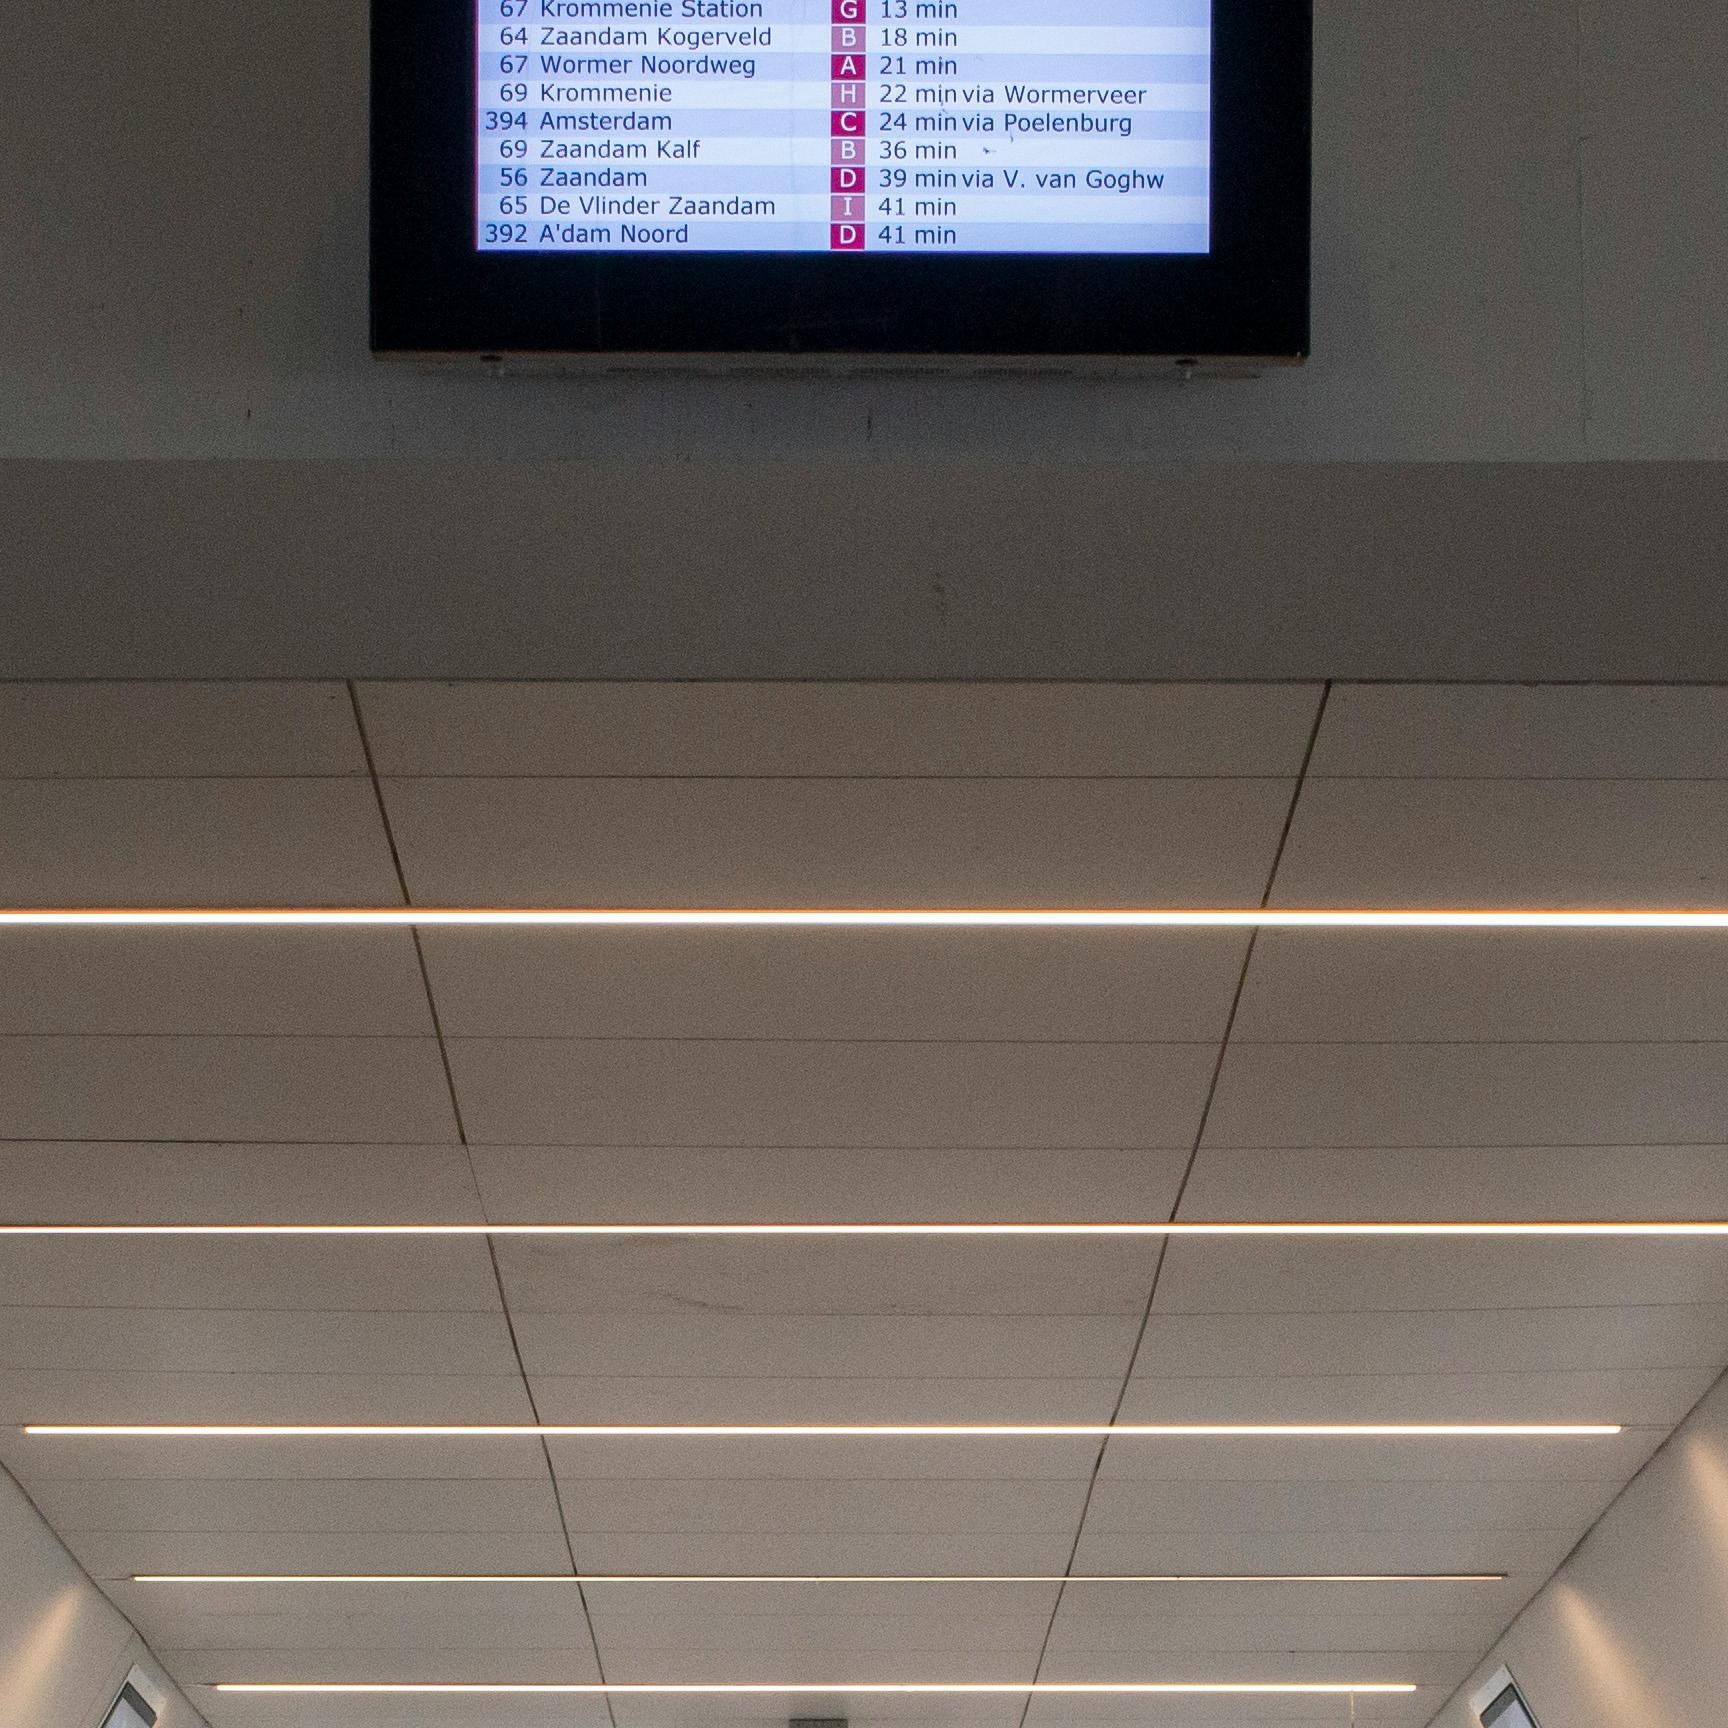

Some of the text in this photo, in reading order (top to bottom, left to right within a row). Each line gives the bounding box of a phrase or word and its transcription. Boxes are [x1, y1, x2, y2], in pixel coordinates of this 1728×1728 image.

[499, 0, 958, 19] 67 Krommenie Station G 13 min
[500, 25, 957, 51] 64 Zaandam Kogerveld B 18 min
[499, 54, 957, 79] 67 Wormer Noordweg A 21 min
[499, 82, 1148, 105] 69 Krommenie H 22 min via Wormerveer
[485, 110, 1132, 137] 394 Amsterdam C 24 min via Poelenburg
[499, 138, 957, 160] 69 Zaandam Kalf B 36 min
[500, 167, 1165, 194] 56 Zaandam D 39 min via V. van Goghw
[499, 195, 957, 217] 65 De Vlinder Zaandam I 41 min
[485, 223, 956, 245] 392 A'dam Noord D 41 min
